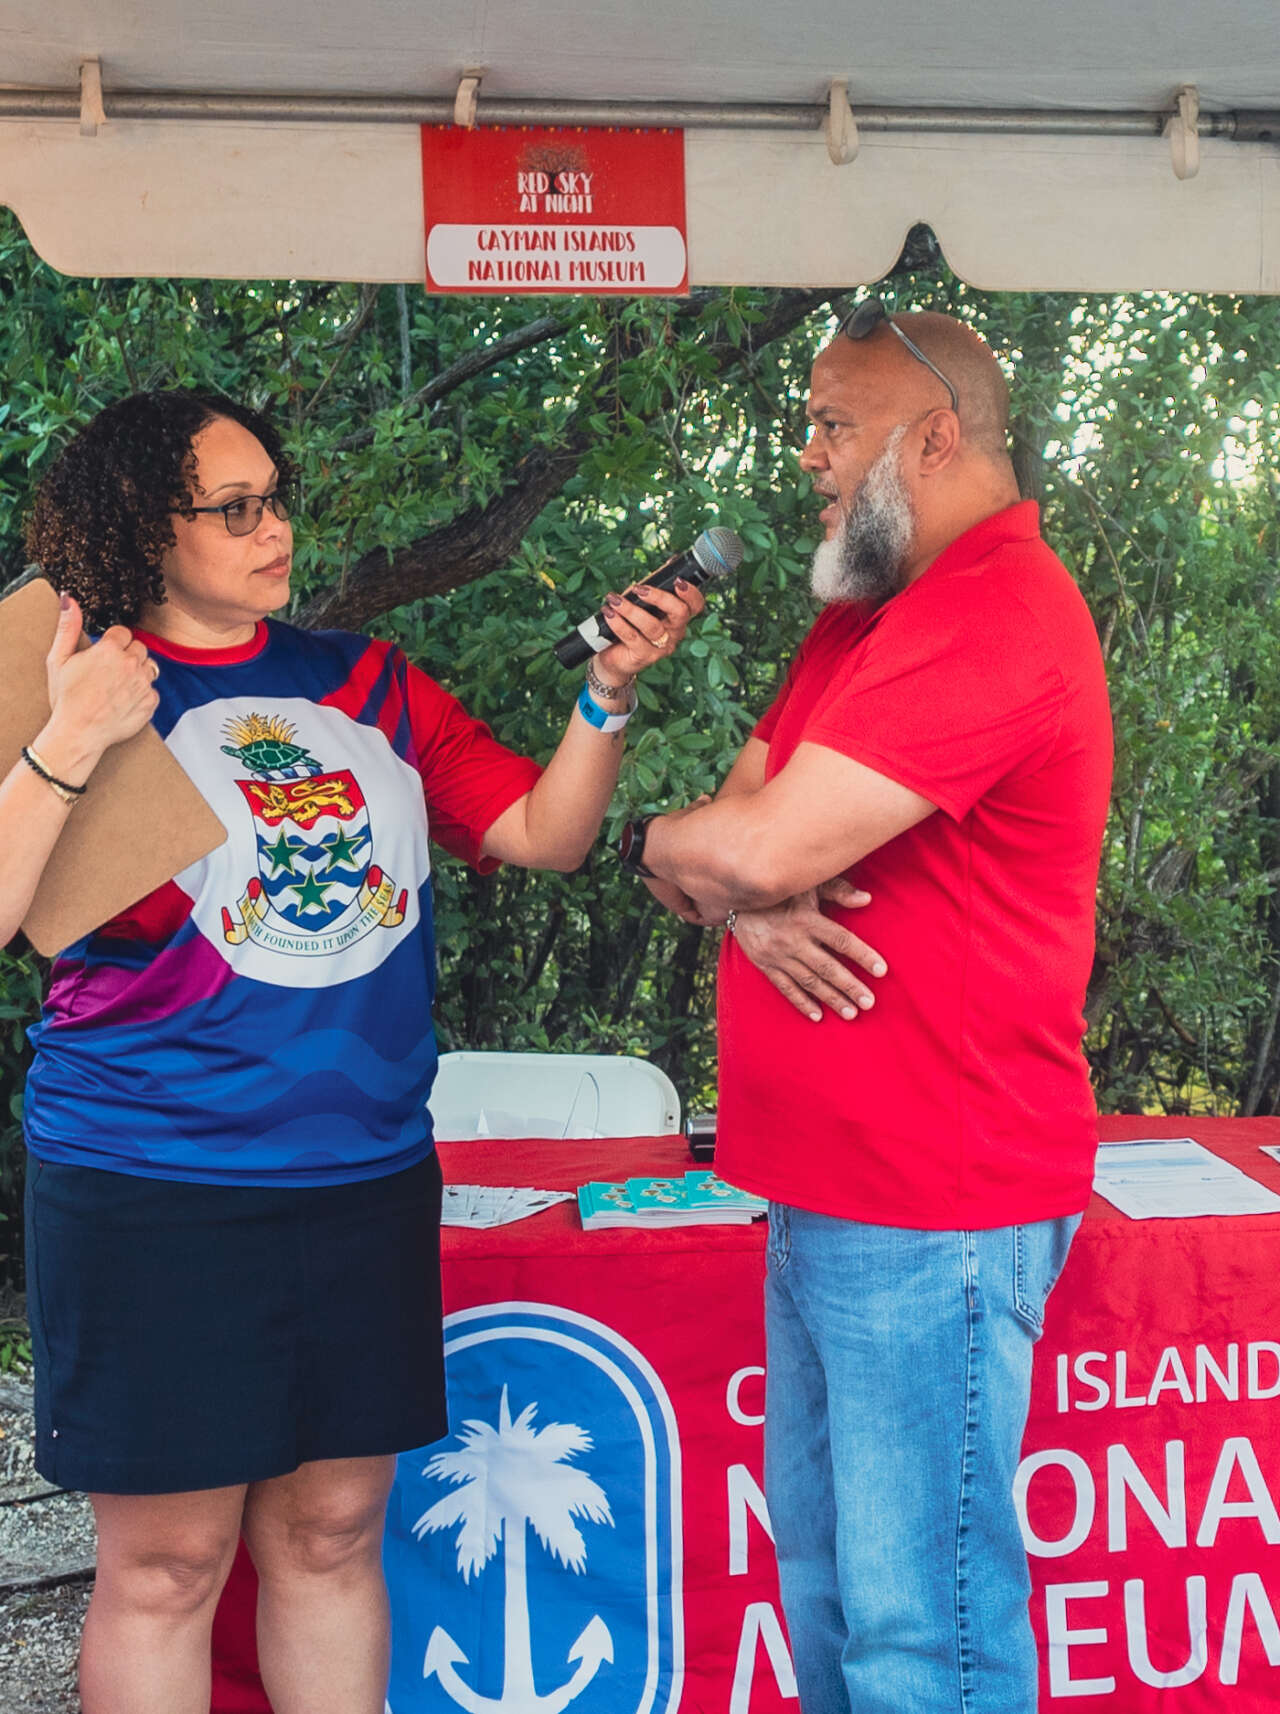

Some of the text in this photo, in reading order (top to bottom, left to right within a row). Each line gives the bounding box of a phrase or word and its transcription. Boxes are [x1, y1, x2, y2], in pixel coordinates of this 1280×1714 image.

[518, 172, 594, 194] RED SKY
[520, 193, 593, 214] AT NIGHT
[477, 229, 636, 252] CAYMAN ISLANDS
[468, 259, 645, 282] NATIONAL MUSEUM
[263, 933, 319, 951] FOUNDED
[323, 939, 333, 949] IT
[336, 924, 359, 946] UPON
[361, 908, 378, 927] THE
